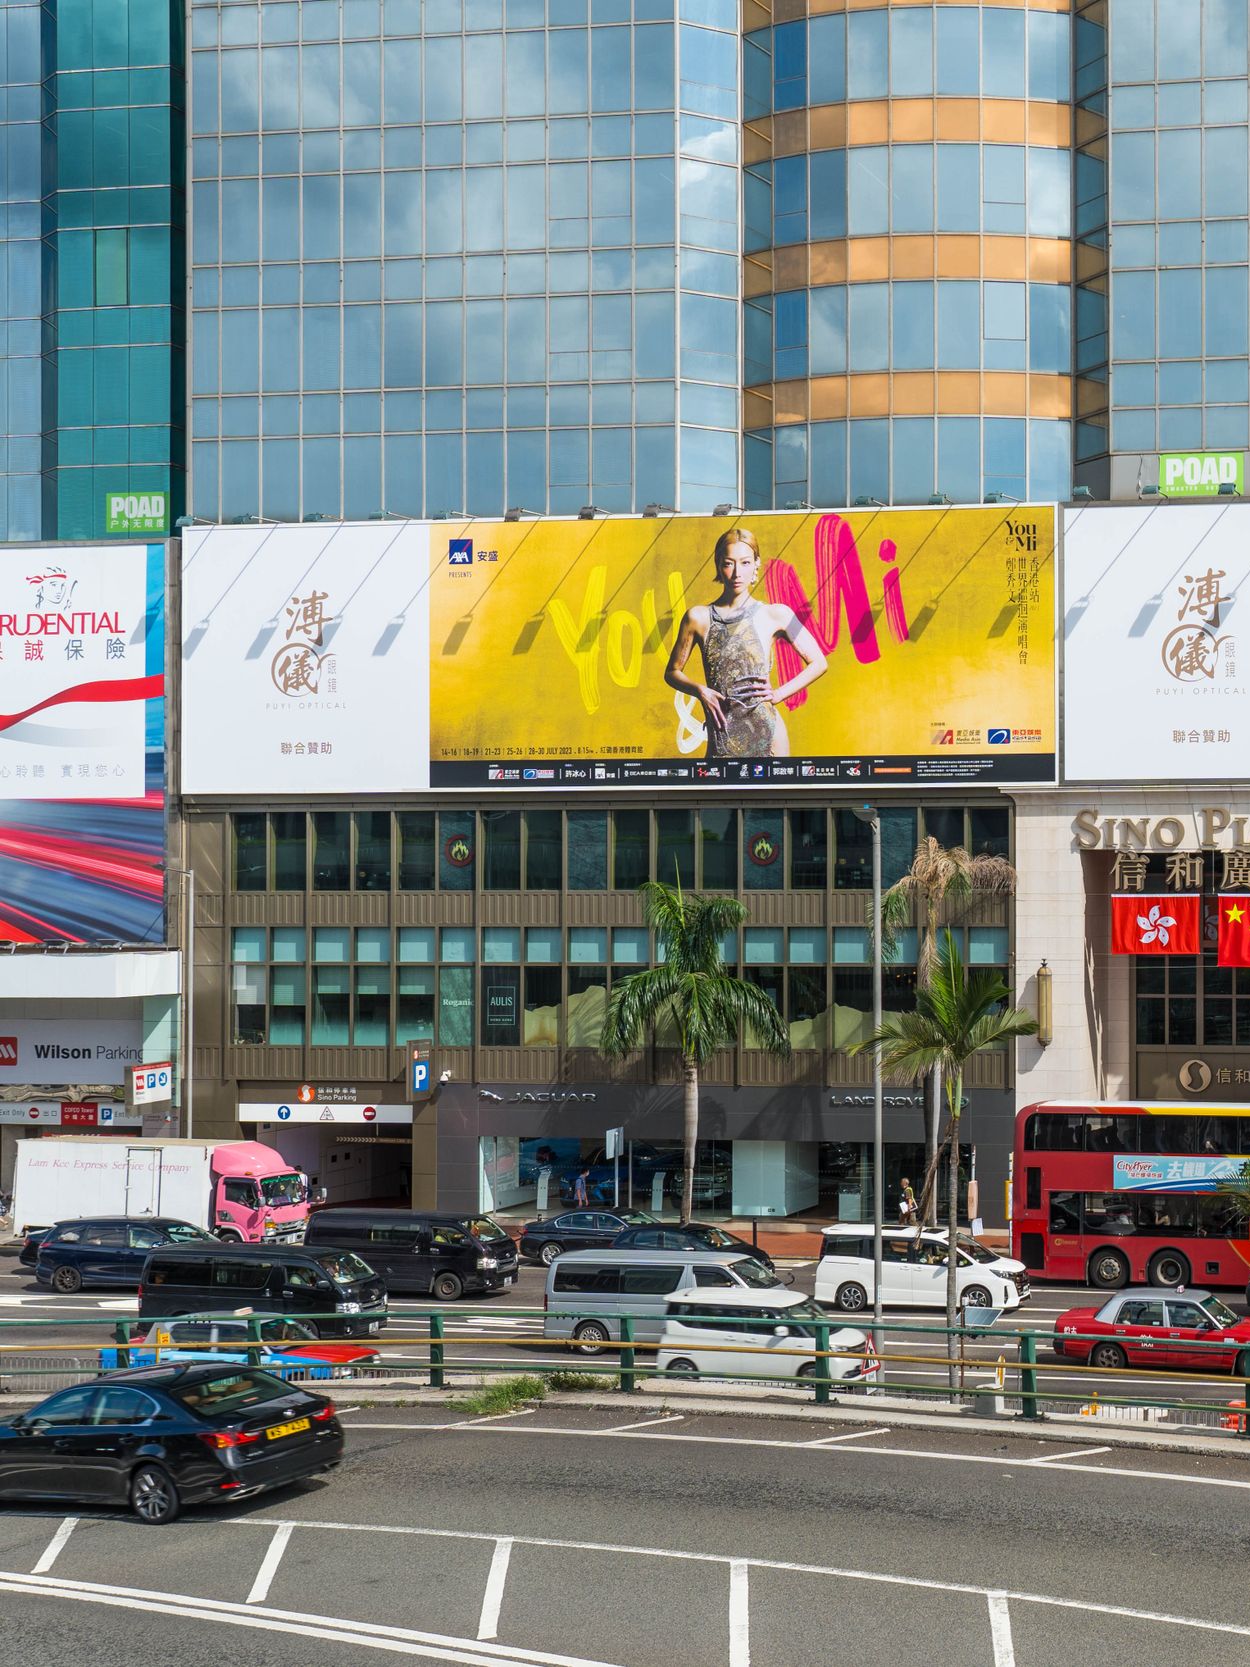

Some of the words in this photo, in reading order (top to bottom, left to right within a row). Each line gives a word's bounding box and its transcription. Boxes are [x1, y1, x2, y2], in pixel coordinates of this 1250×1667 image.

[1165, 457, 1237, 485] POAD
[111, 496, 165, 518] POAD
[1003, 520, 1037, 536] You
[1015, 536, 1036, 551] Mi
[449, 551, 469, 563] AXA
[477, 550, 498, 562] 安盛
[1029, 557, 1039, 603] 香港站
[764, 514, 910, 712] Mi
[0, 612, 126, 636] RUDENTIAL
[547, 565, 688, 715] You
[1225, 642, 1236, 678] 眼鏡
[1155, 688, 1185, 696] PUYI
[1192, 687, 1247, 695] OPTICAL
[298, 702, 347, 710] OPTICAL
[1074, 809, 1186, 848] SINO
[490, 996, 513, 1006] AULIS
[35, 1044, 91, 1059] Wilson
[97, 1045, 143, 1063] Parking
[415, 1065, 426, 1089] P
[510, 1092, 597, 1101] JAGUAR
[883, 1096, 924, 1106] ROVE
[12, 1108, 25, 1117] Only
[28, 1158, 48, 1167] Lam
[74, 1160, 108, 1170] Express
[112, 1161, 144, 1170] Service
[148, 1162, 191, 1174] Company
